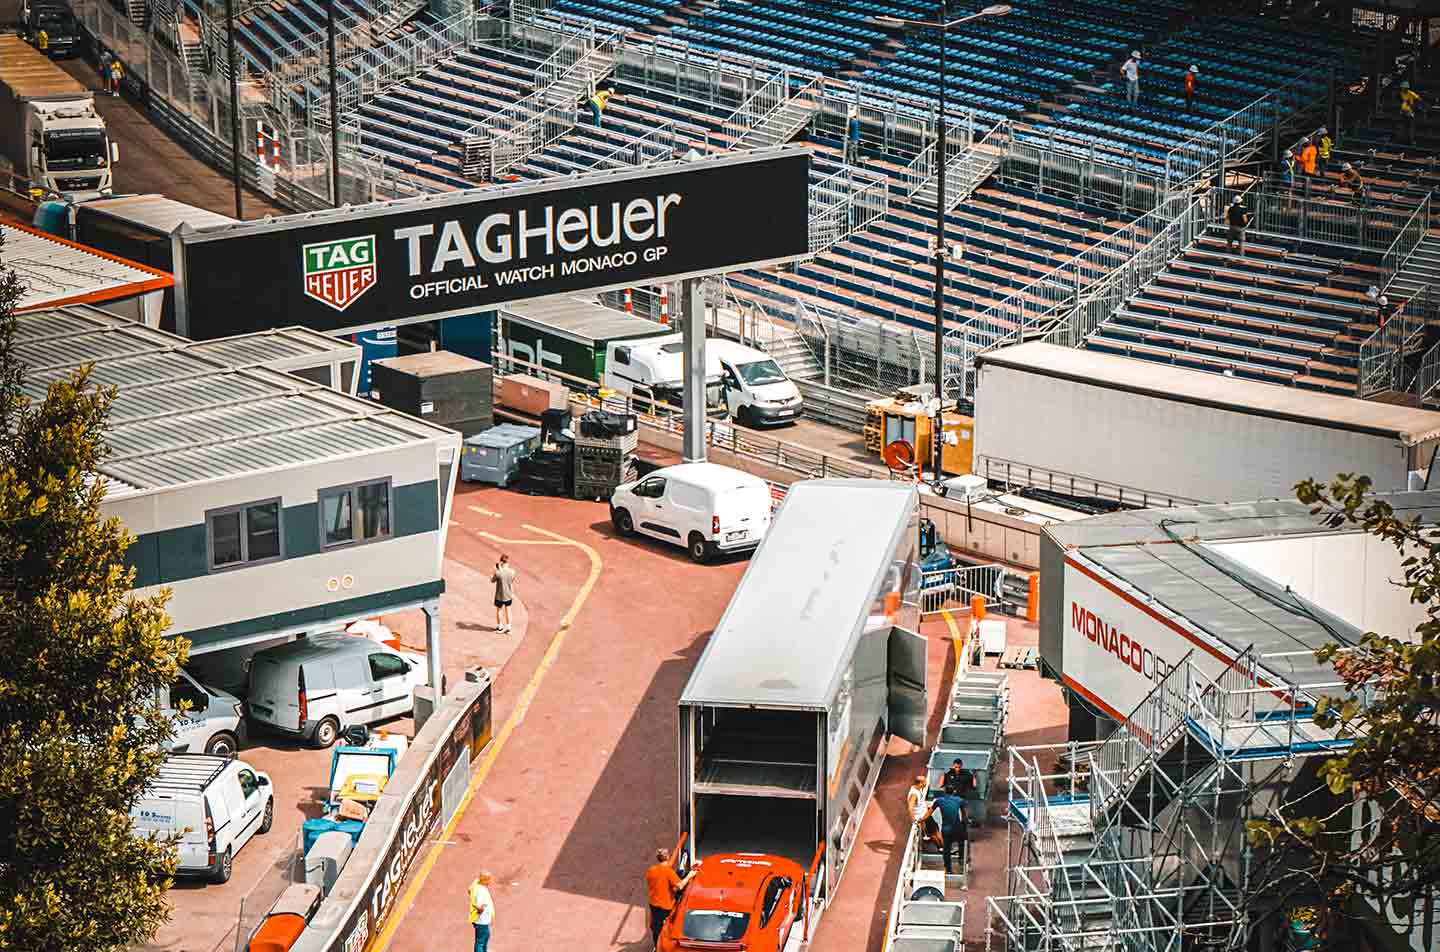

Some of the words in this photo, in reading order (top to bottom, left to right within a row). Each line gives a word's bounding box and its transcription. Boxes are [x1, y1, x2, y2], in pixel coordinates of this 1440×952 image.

[309, 240, 370, 269] TAG
[392, 192, 683, 277] TAGHeuer
[308, 268, 372, 305] HEUER
[409, 274, 489, 300] OFFICIAL
[494, 263, 555, 285] WATCH
[561, 250, 638, 276] MONACO
[644, 246, 669, 262] GP
